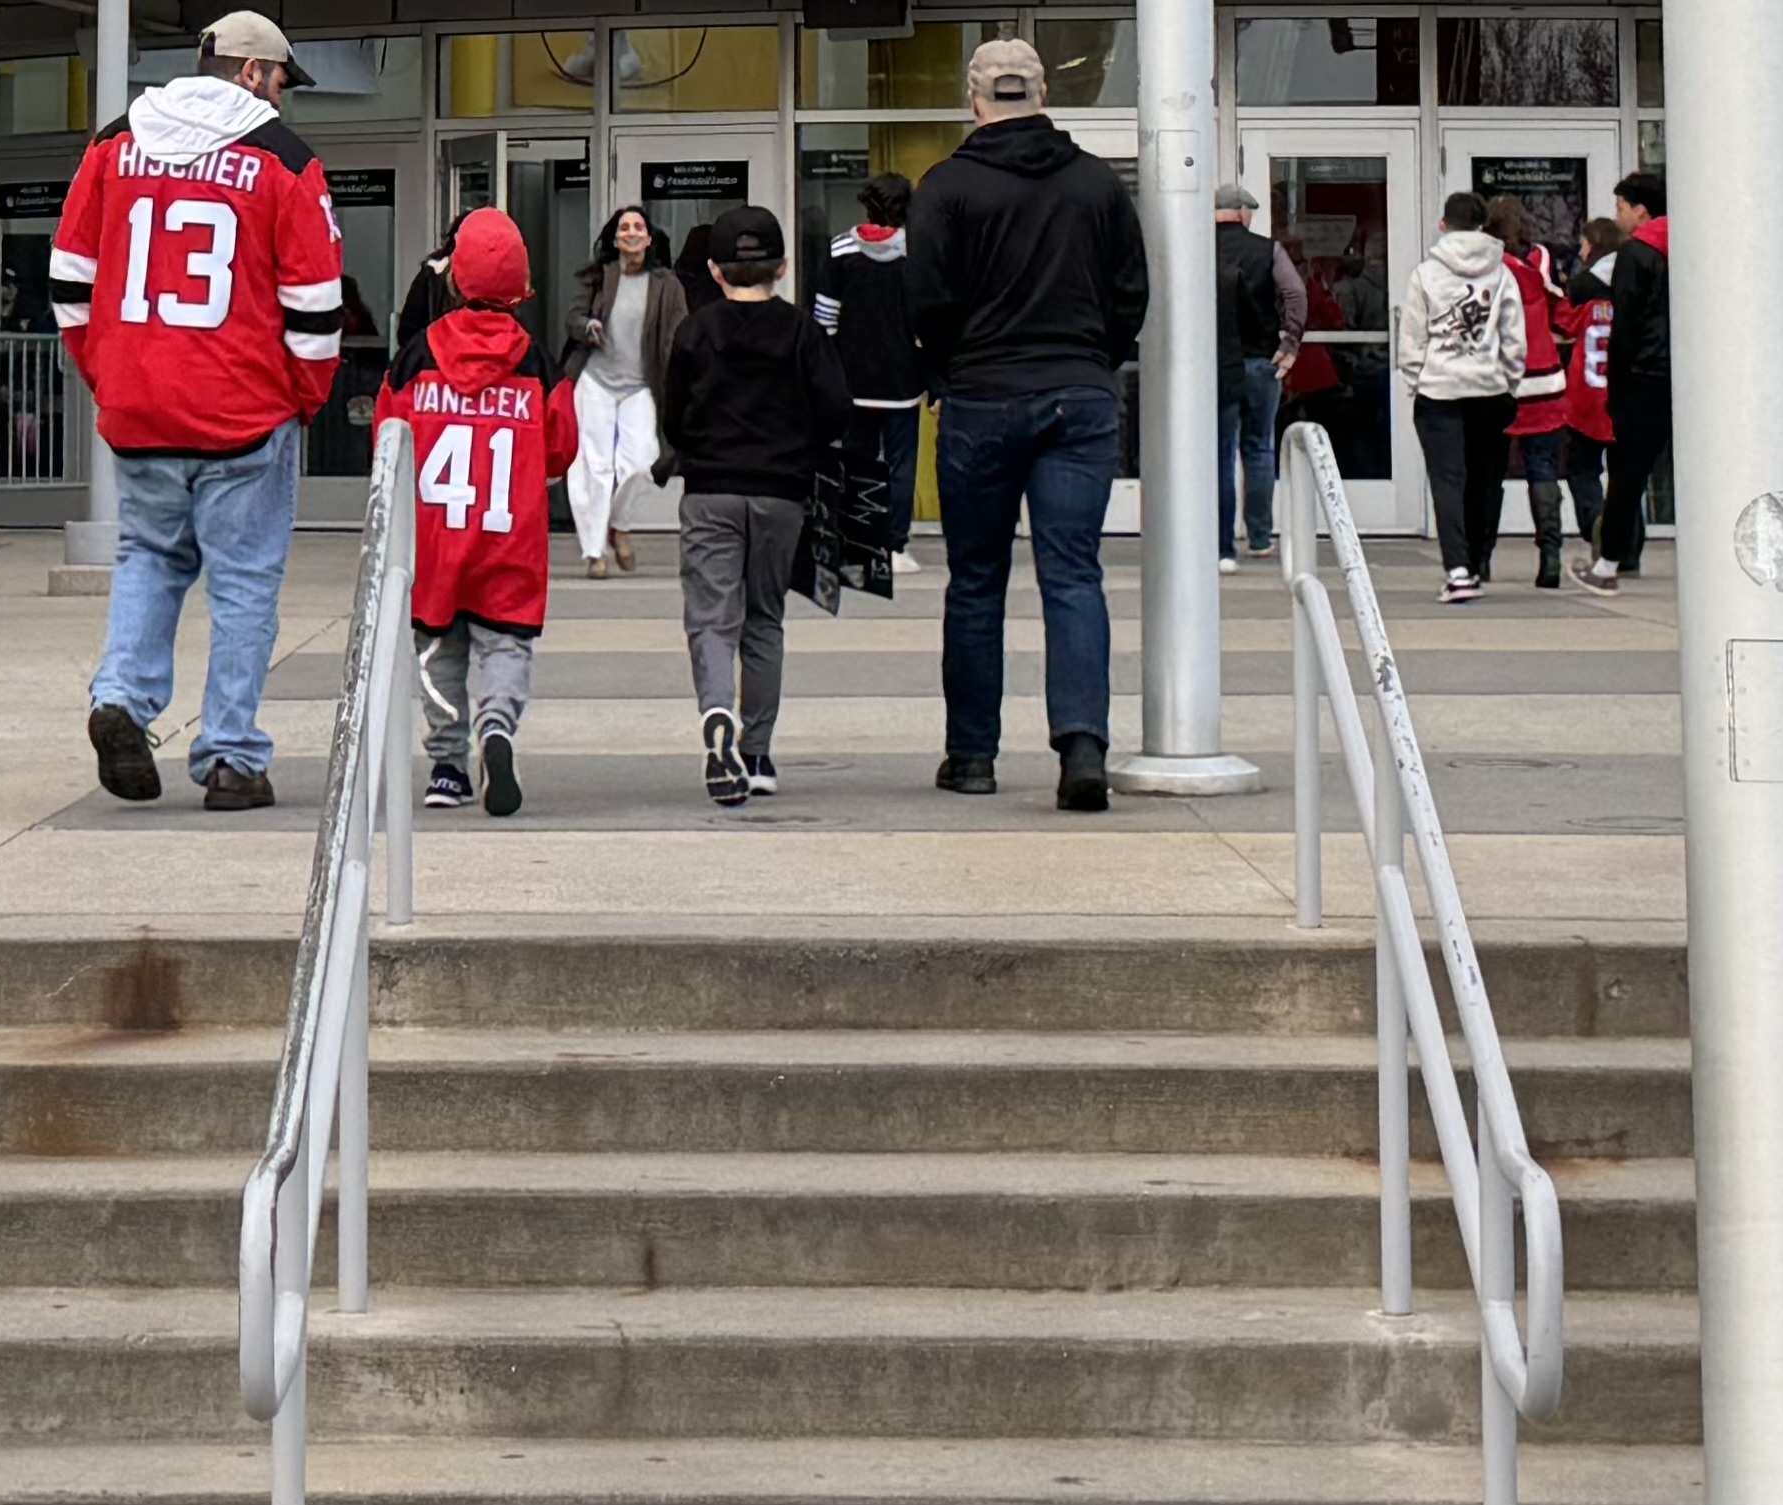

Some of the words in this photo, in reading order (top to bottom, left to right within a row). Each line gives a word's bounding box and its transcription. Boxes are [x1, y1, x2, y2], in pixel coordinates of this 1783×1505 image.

[120, 196, 237, 329] 13
[414, 381, 532, 420] VANECEK
[418, 423, 514, 533] 41
